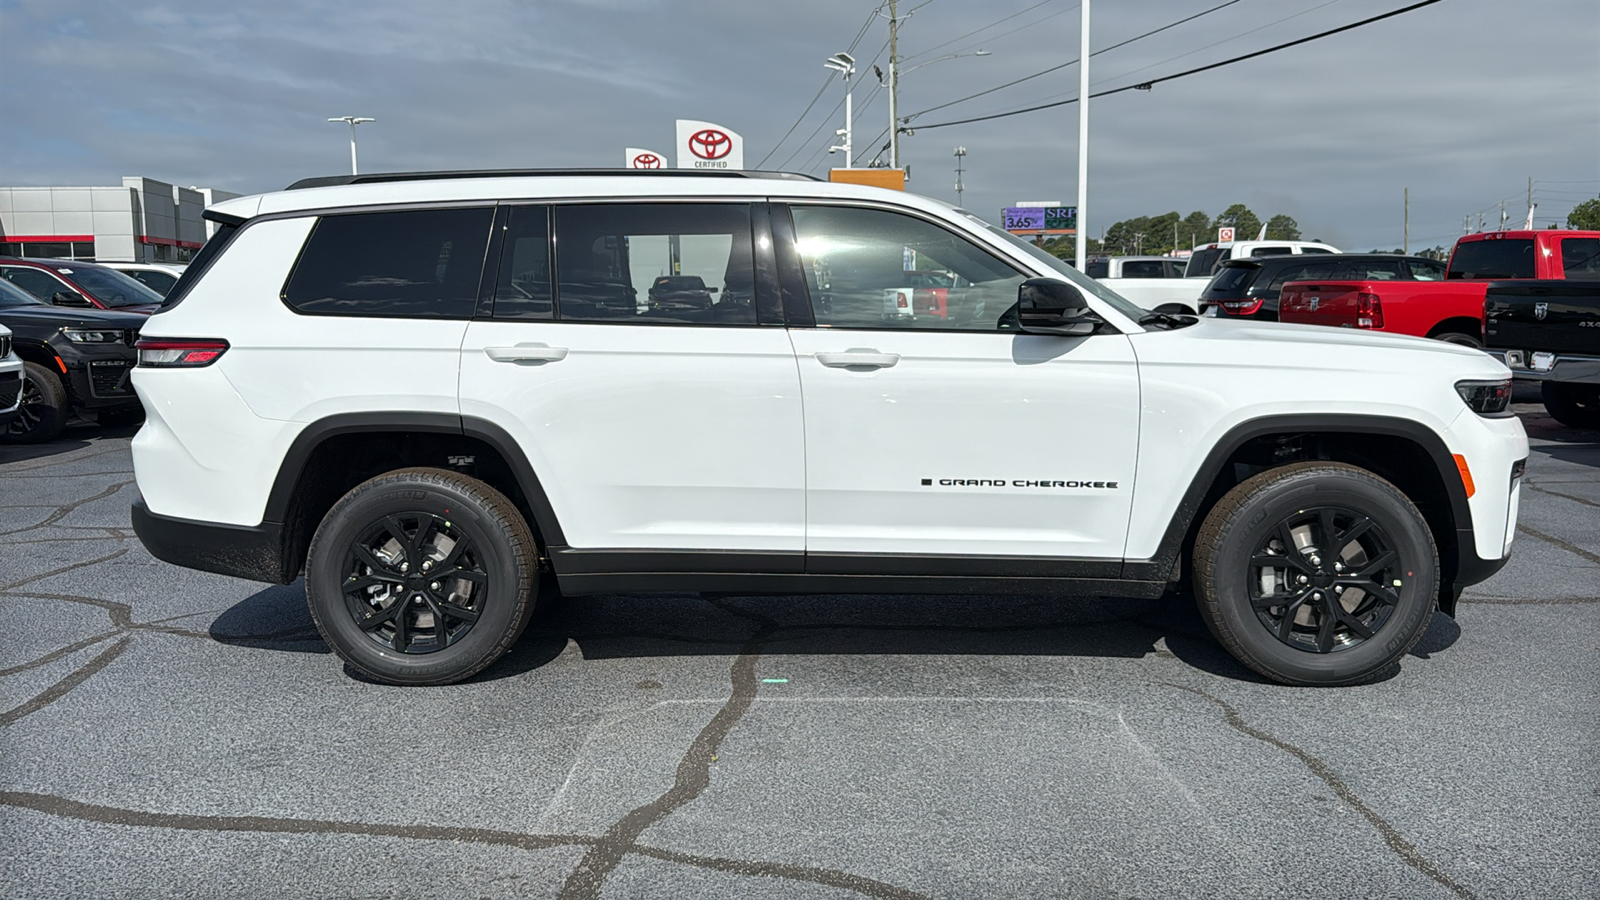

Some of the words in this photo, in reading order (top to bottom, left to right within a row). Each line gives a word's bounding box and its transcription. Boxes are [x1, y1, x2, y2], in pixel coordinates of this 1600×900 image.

[1046, 208, 1076, 218] SRP
[938, 478, 1007, 487] GRAND
[1012, 479, 1119, 489] CHEROKEE
